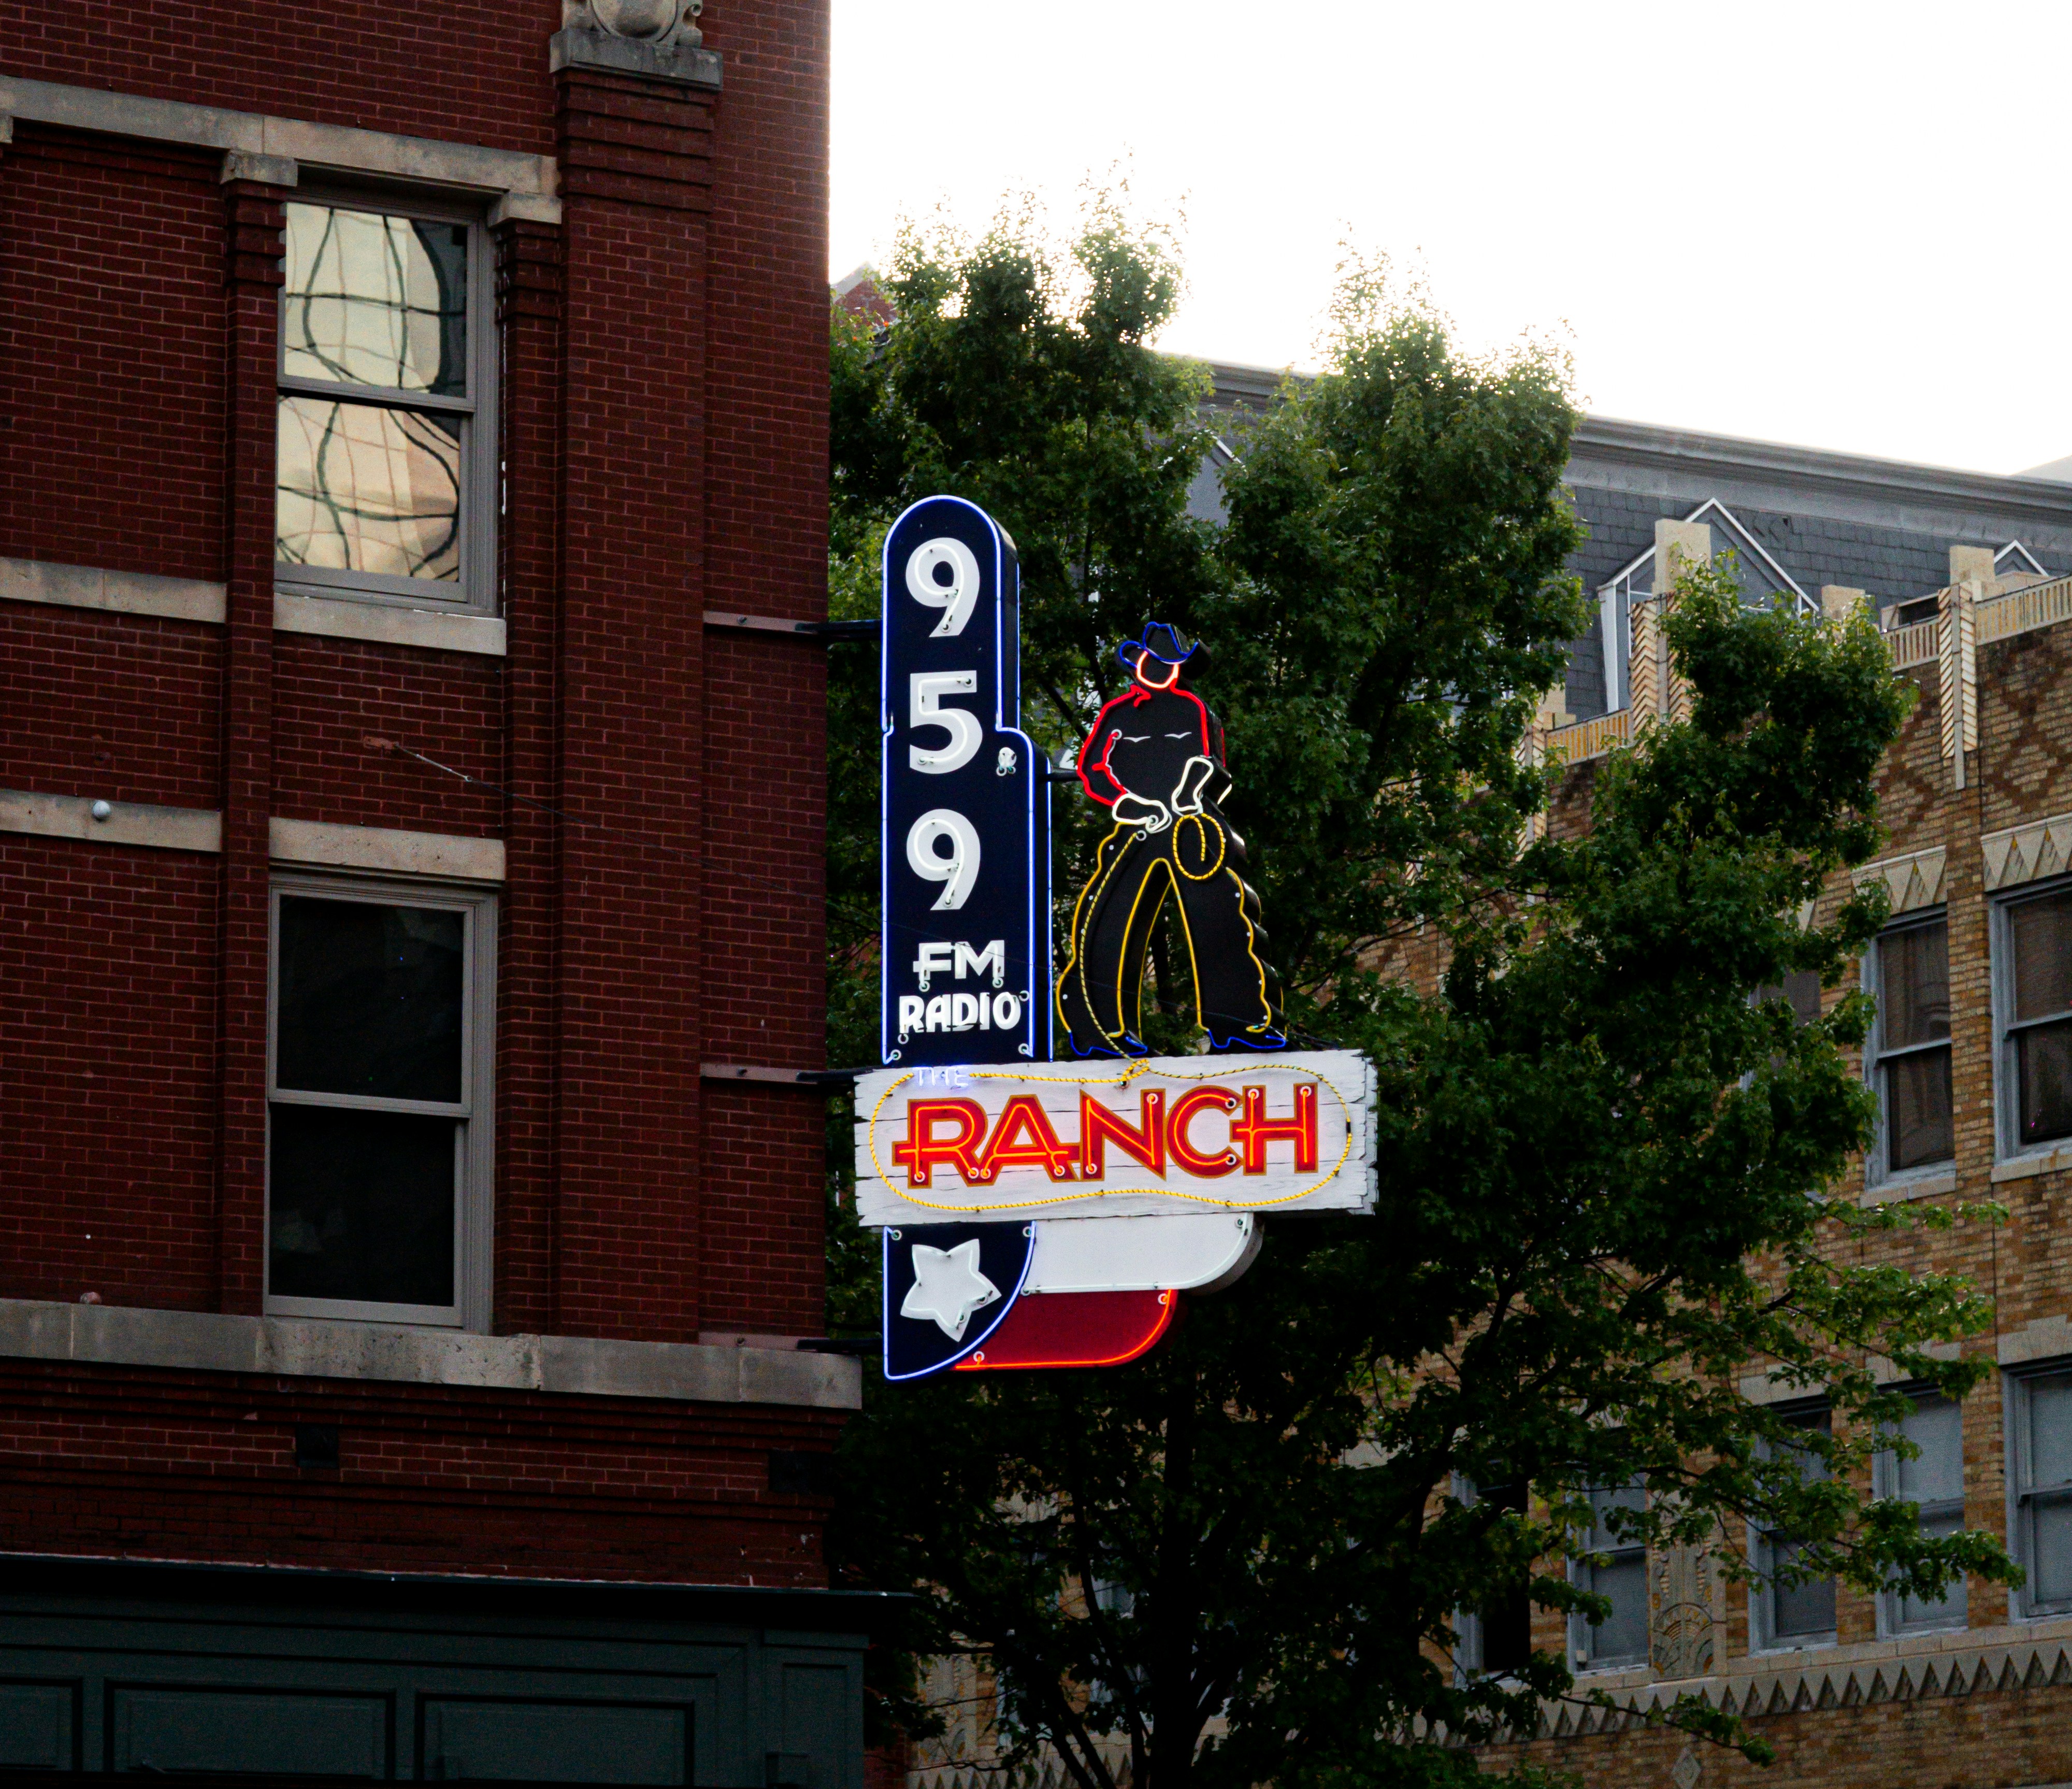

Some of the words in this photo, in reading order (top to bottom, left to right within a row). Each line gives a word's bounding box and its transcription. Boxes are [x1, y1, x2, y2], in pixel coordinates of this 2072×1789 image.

[913, 940, 1004, 980] FM
[899, 992, 1021, 1033] RADIO
[912, 1066, 969, 1087] THE
[892, 1082, 1319, 1189] RANCH
